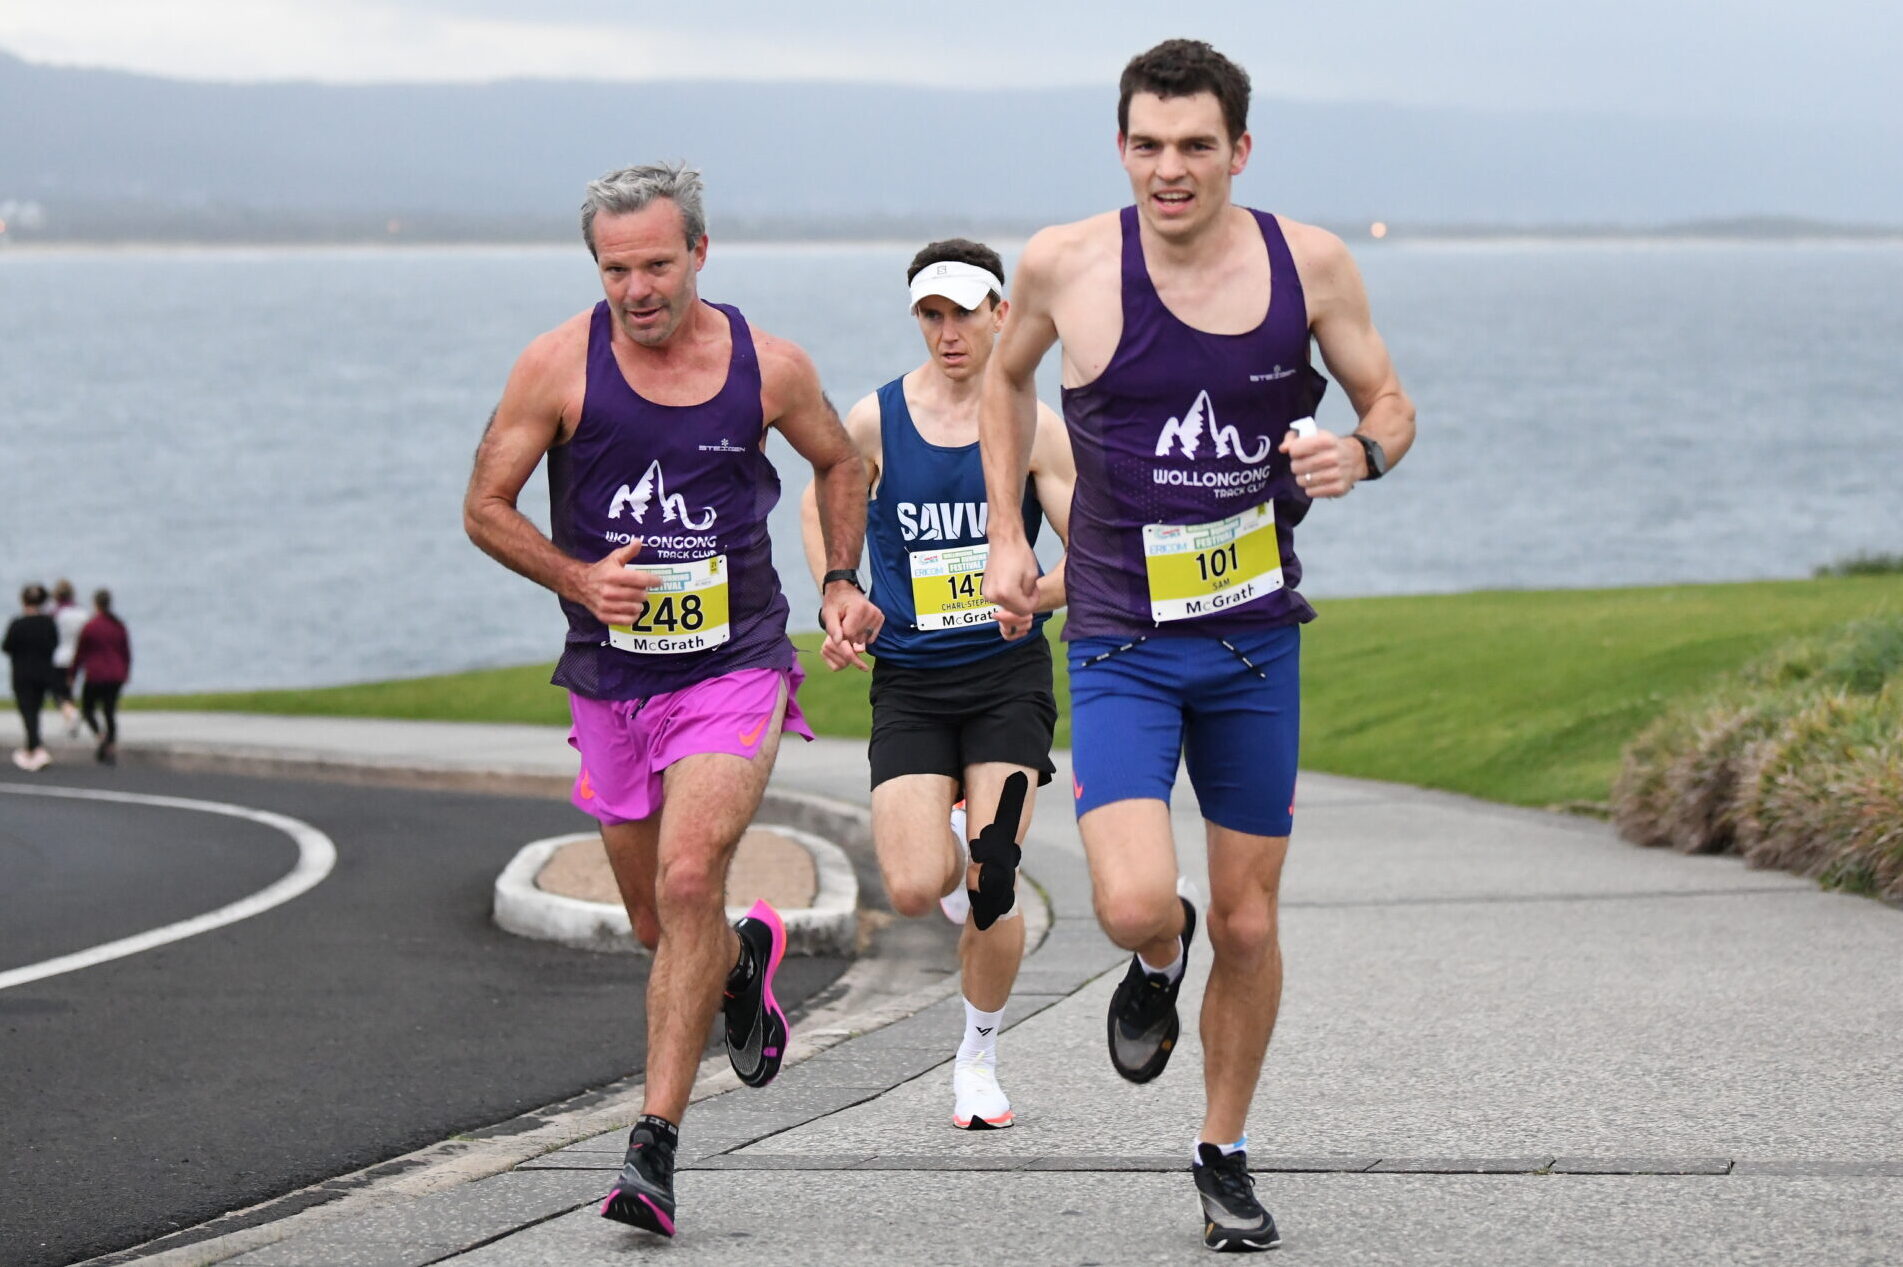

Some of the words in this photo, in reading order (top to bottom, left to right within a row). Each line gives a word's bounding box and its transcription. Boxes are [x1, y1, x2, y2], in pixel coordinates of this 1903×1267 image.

[1153, 465, 1271, 488] WOLLONGONG
[1213, 486, 1245, 499] TRACK
[657, 550, 690, 559] TRACK
[1196, 543, 1239, 581] 101
[948, 572, 984, 600] 147
[1212, 578, 1231, 591] SAM
[941, 597, 996, 611] CHARL-STEPH
[1185, 583, 1255, 615] McGrath
[632, 594, 704, 633] 248
[633, 636, 704, 652] McGrath
